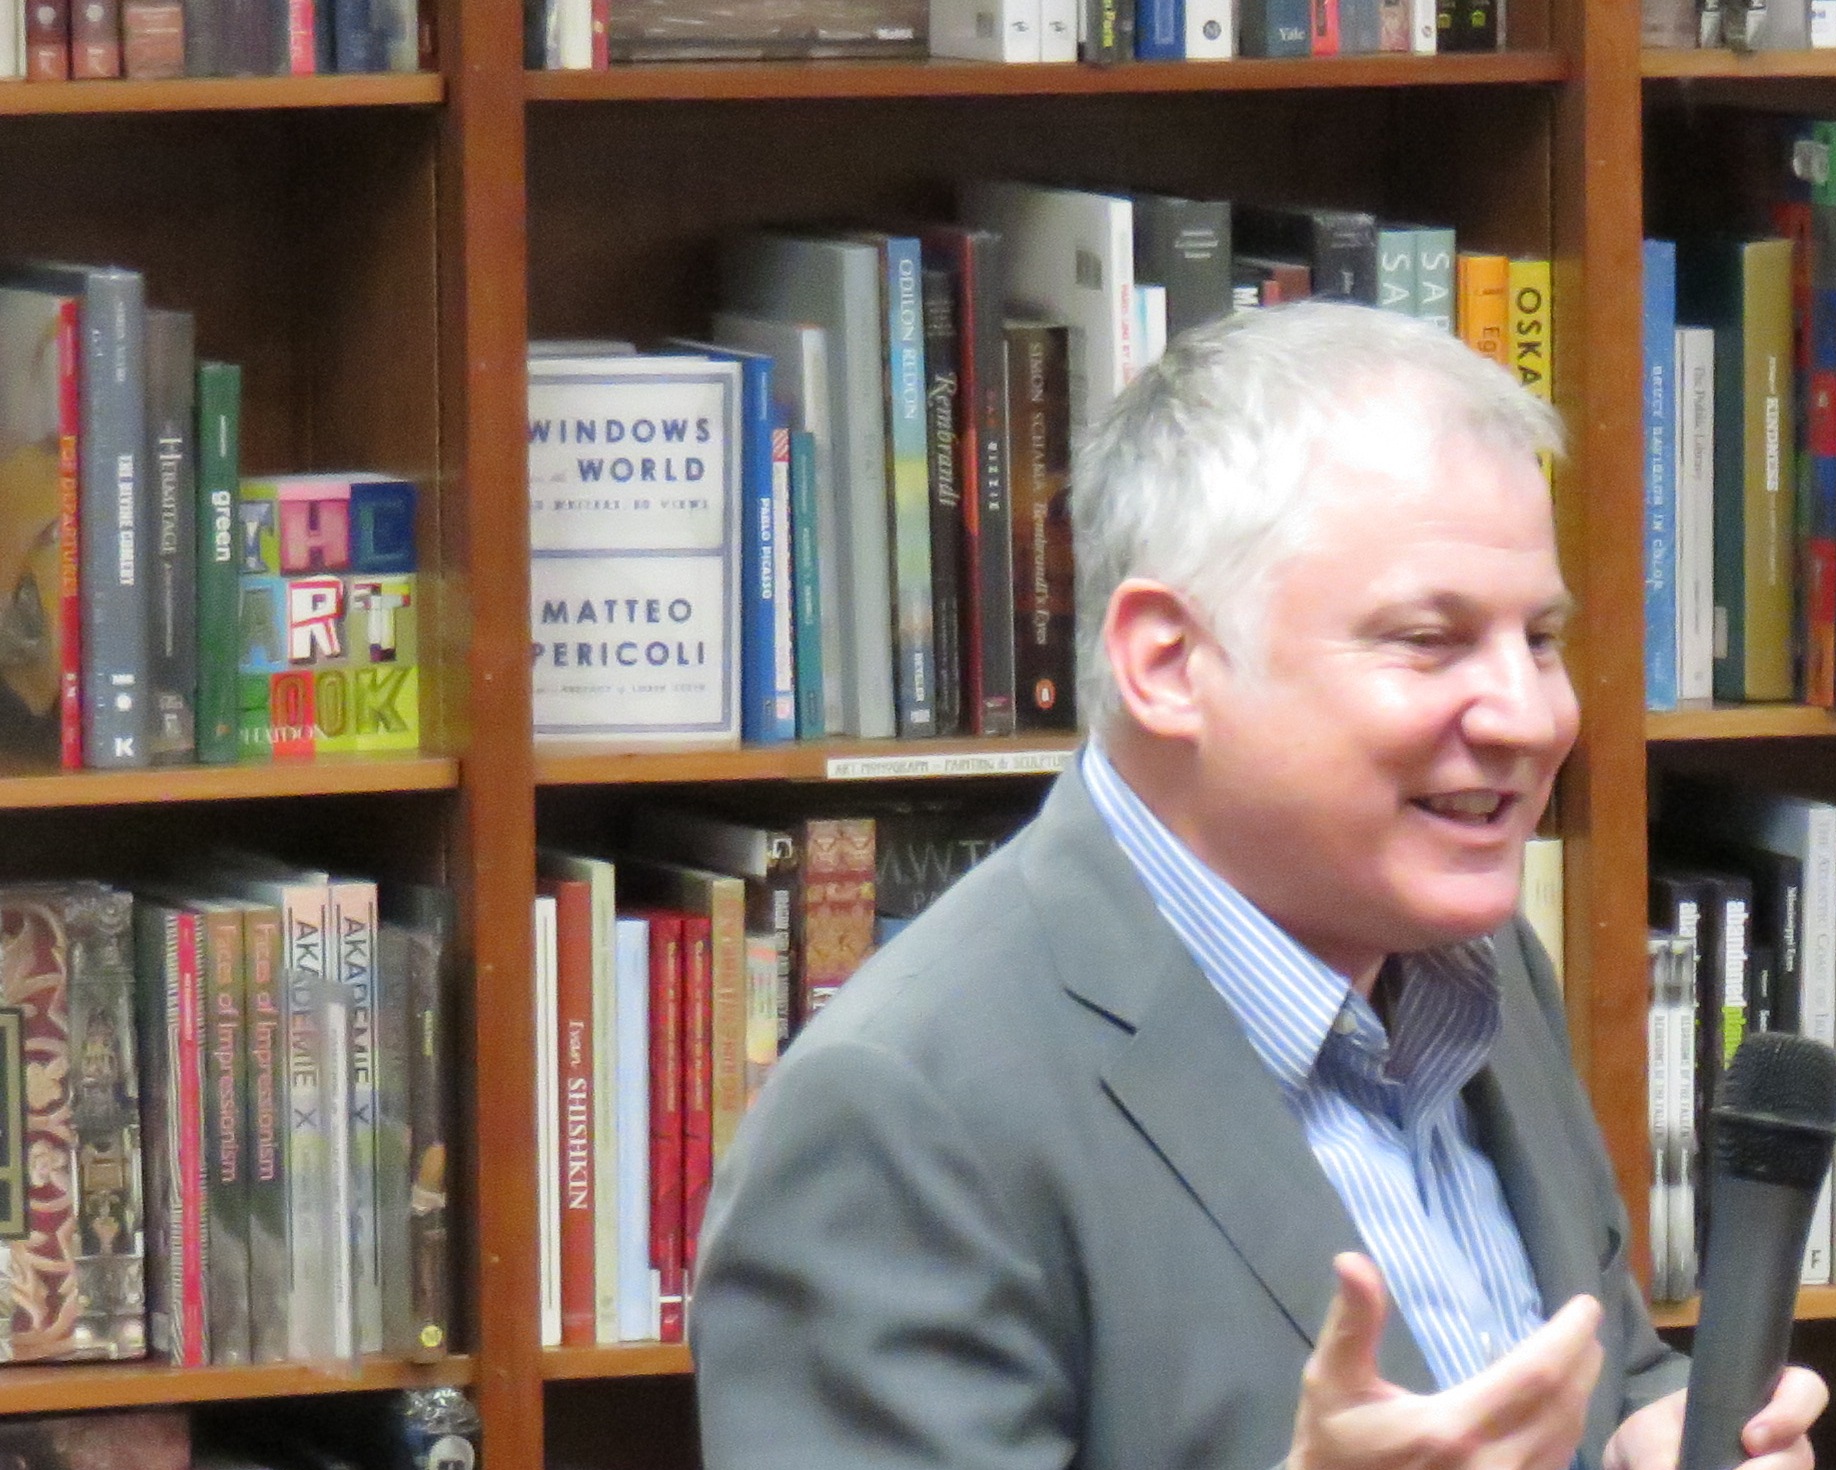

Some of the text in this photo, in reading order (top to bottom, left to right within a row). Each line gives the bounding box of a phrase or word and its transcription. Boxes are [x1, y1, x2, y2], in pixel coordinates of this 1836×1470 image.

[1278, 26, 1306, 41] Yale
[899, 258, 919, 420] ODILON REDON
[1030, 341, 1044, 402] SIMON
[1516, 286, 1543, 390] OSKA
[528, 417, 712, 443] WINDOWS
[928, 371, 958, 508] Rembrandt
[159, 437, 183, 556] HERMITAGE
[577, 456, 707, 483] WORLD
[211, 490, 233, 562] green
[760, 497, 772, 599] PABLO PICASSO
[541, 597, 693, 625] MATTEO
[531, 640, 705, 666] PERICOLI
[1724, 900, 1748, 1007] abandoned
[217, 993, 238, 1015] of
[256, 992, 276, 1013] of
[213, 1021, 239, 1183] Impressionism
[251, 1021, 278, 1181] Impressionism
[294, 1107, 320, 1129] X
[567, 1019, 589, 1209] Ivan SHISHKIN
